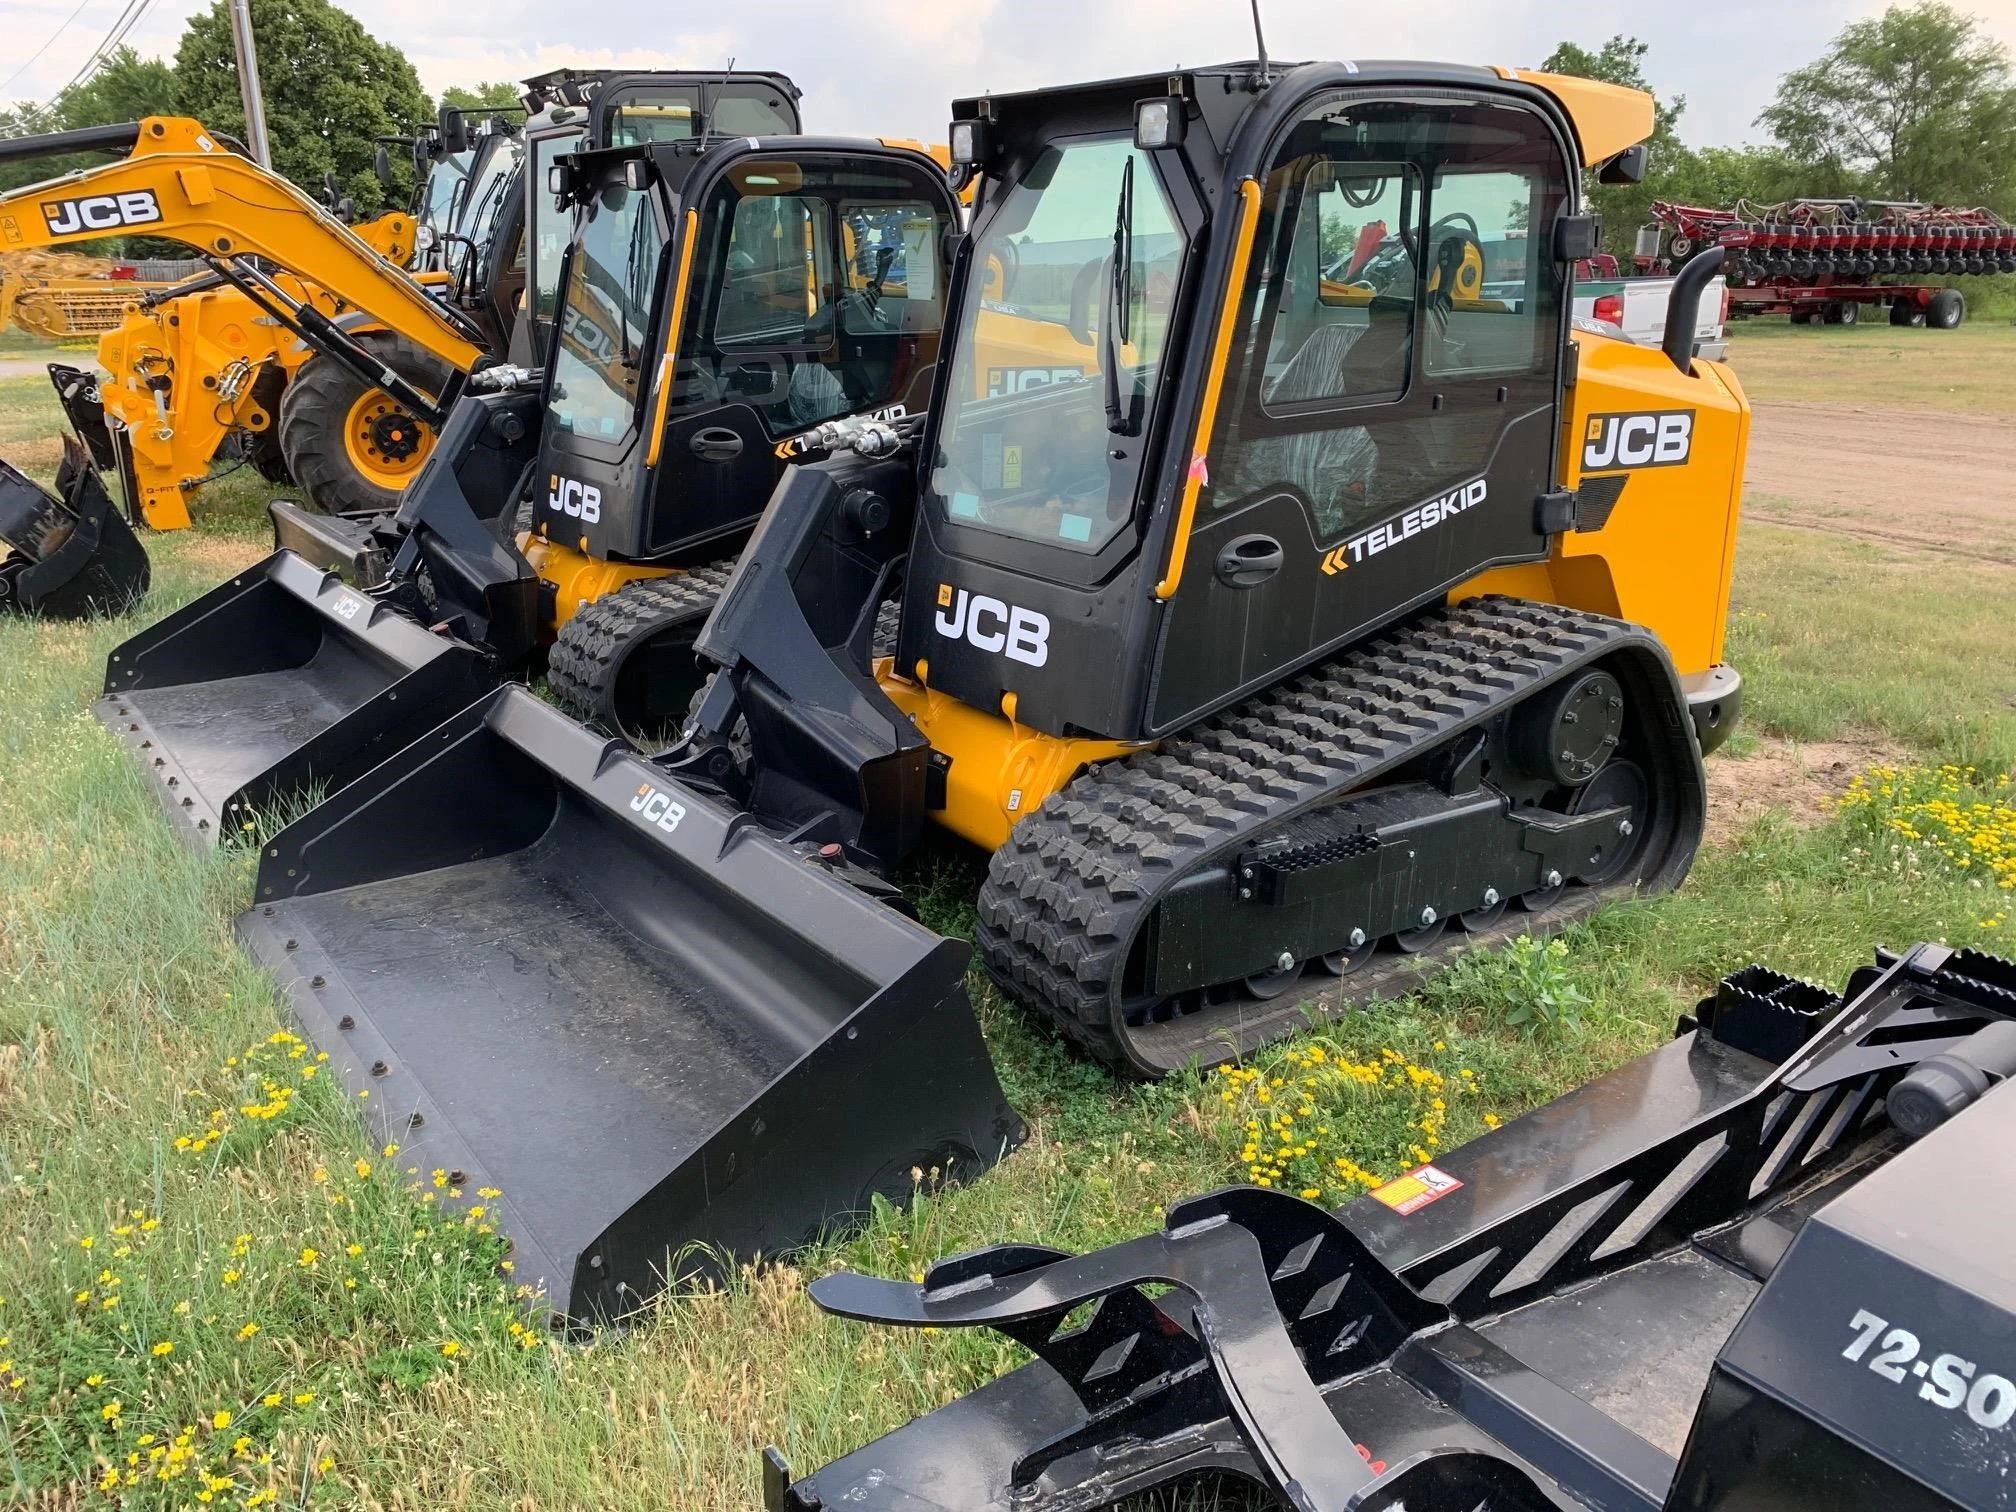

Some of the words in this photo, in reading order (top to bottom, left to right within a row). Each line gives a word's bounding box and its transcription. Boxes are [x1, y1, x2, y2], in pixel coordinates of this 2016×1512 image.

[48, 192, 160, 234] JCB
[1584, 414, 1692, 468] JCB
[549, 476, 602, 524] JCB
[1348, 479, 1487, 563] TELESKID
[332, 597, 361, 620] JCB
[935, 588, 1051, 668] JCB
[629, 788, 687, 833] JCB
